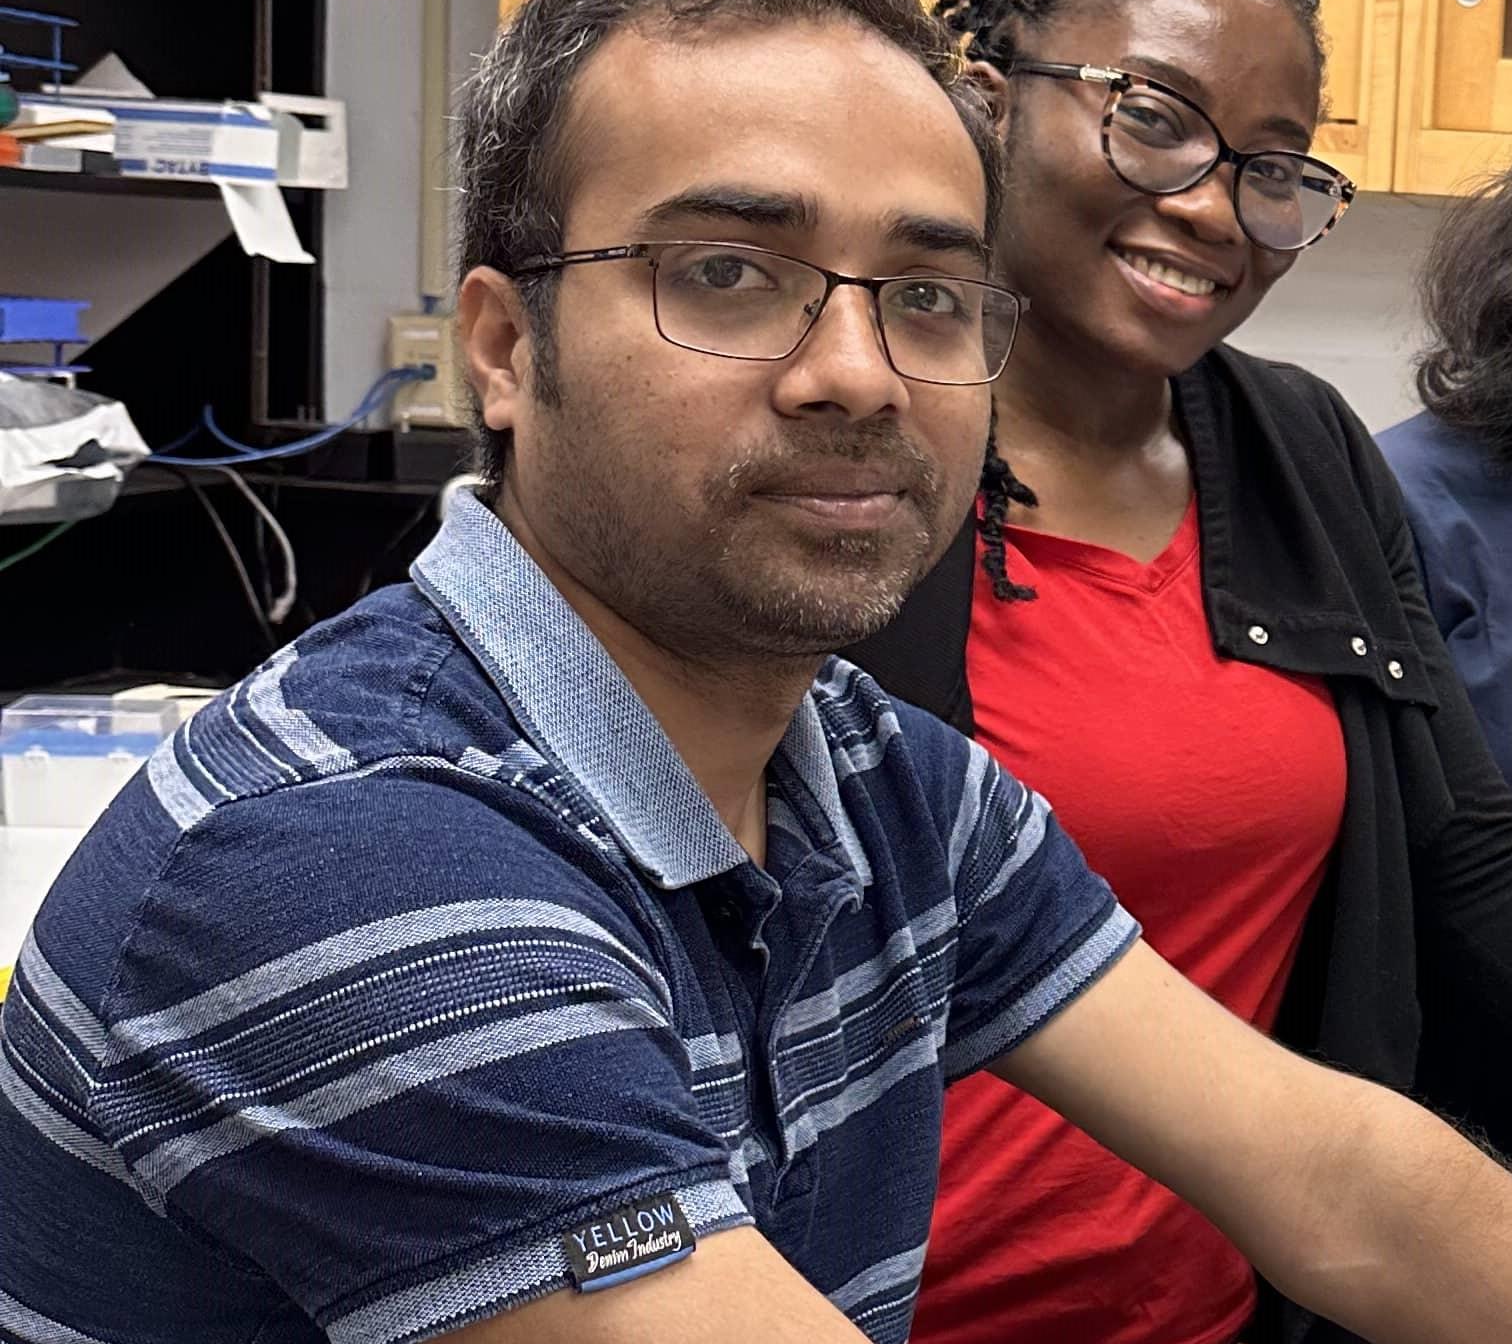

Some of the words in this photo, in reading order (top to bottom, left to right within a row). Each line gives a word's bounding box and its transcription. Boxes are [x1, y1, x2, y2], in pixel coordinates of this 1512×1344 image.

[572, 1203, 674, 1253] YELLOW
[586, 1249, 628, 1273] Denim
[626, 1230, 682, 1260] Industry
